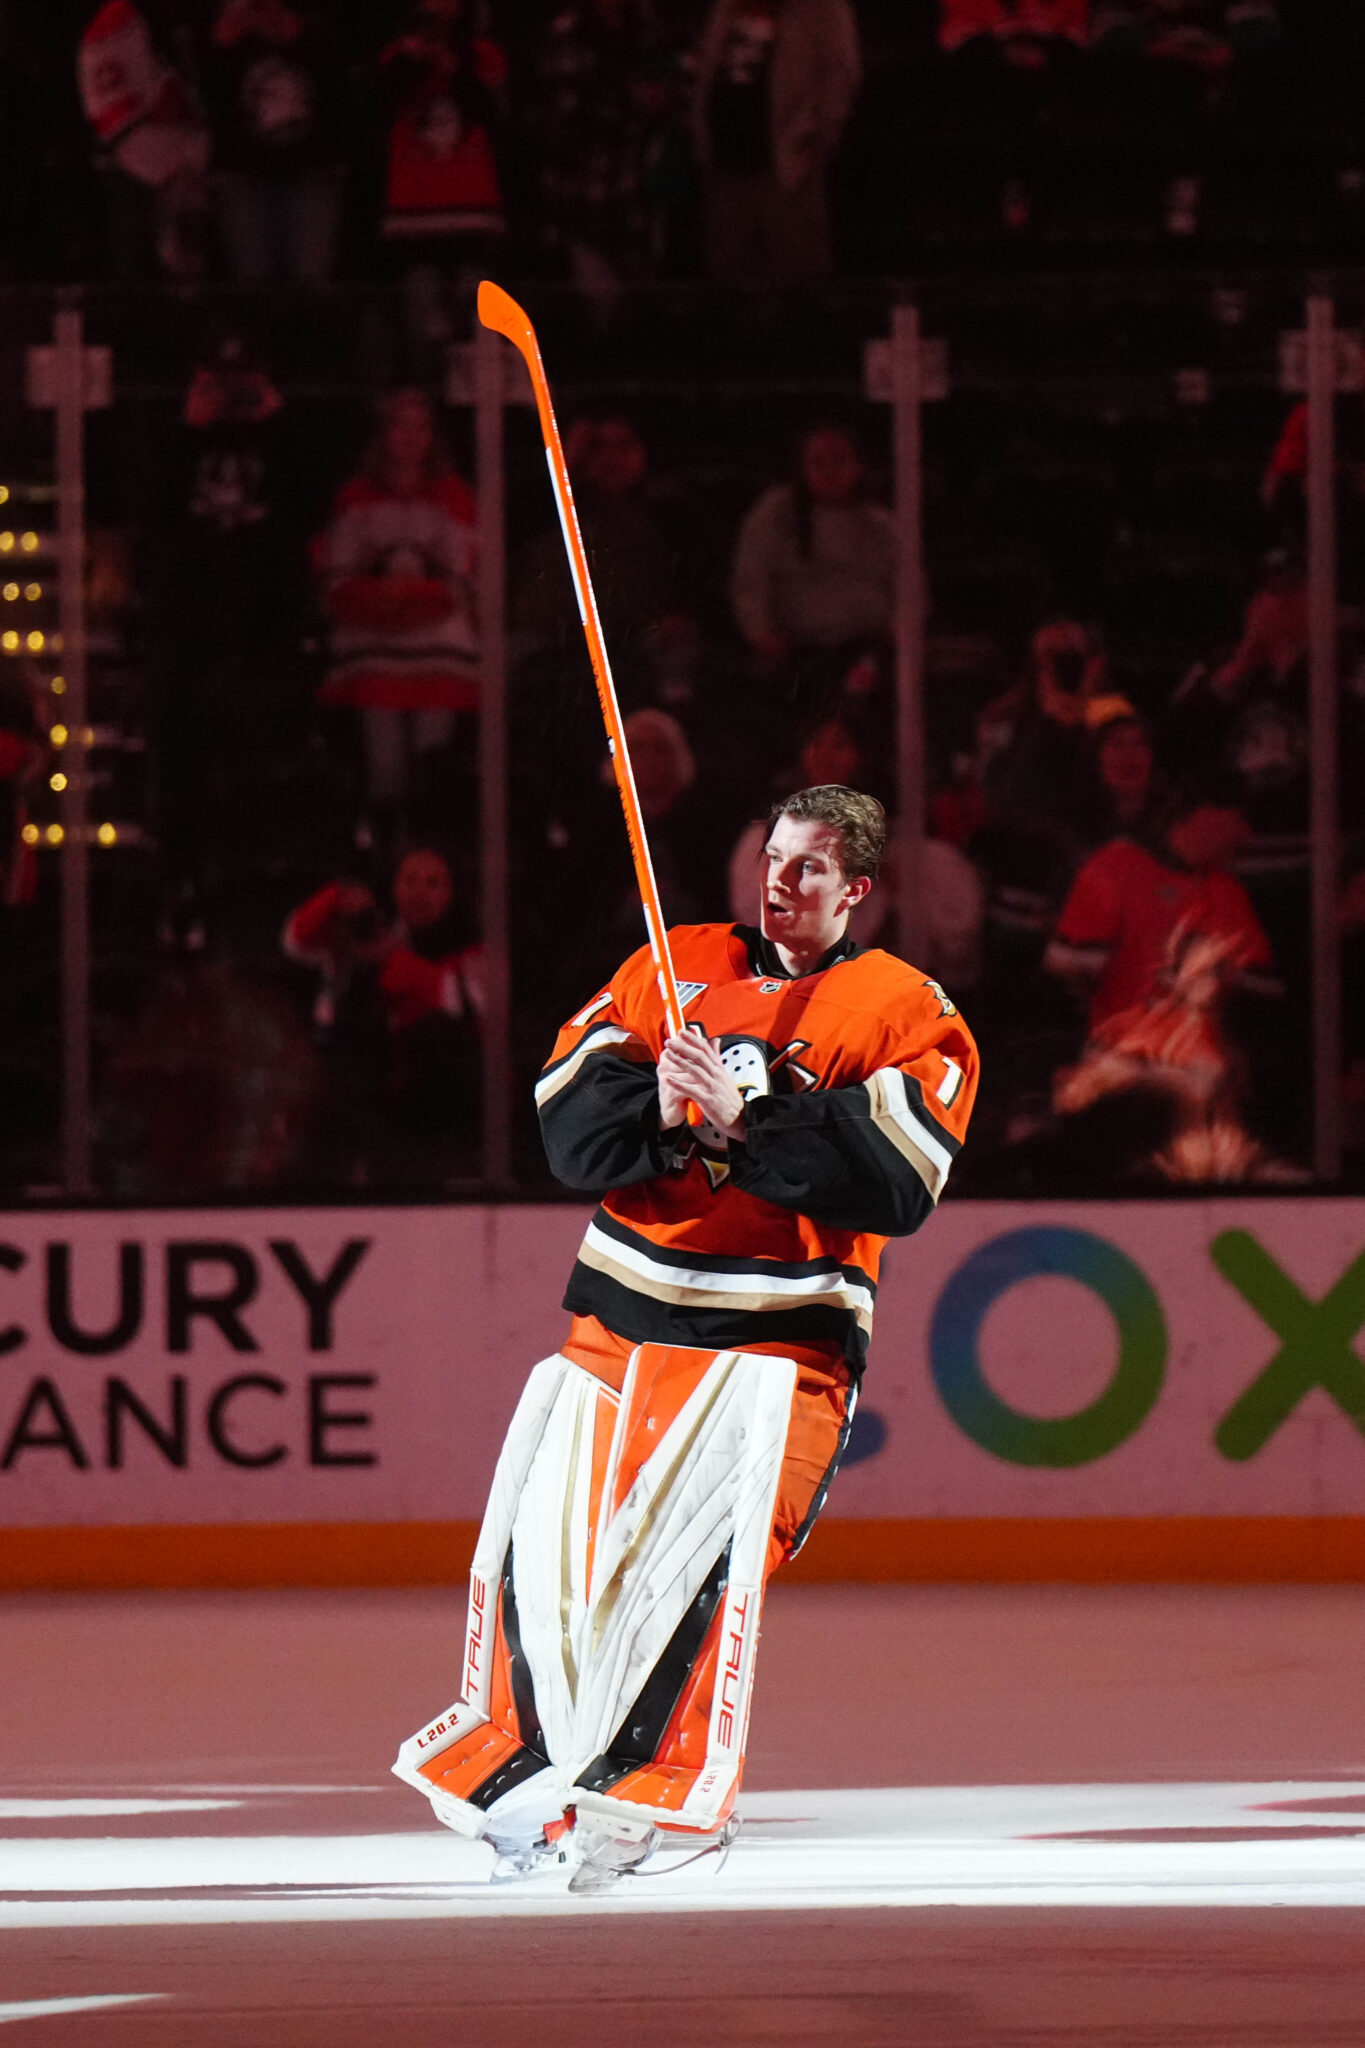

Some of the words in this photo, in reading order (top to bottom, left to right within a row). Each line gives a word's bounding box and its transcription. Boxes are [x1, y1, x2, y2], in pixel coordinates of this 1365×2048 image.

[838, 1224, 1365, 1468] OX
[0, 1371, 380, 1470] ANCE
[465, 1573, 486, 1699] TRUE
[717, 1591, 748, 1750] TRUE
[416, 1712, 460, 1749] L20.2
